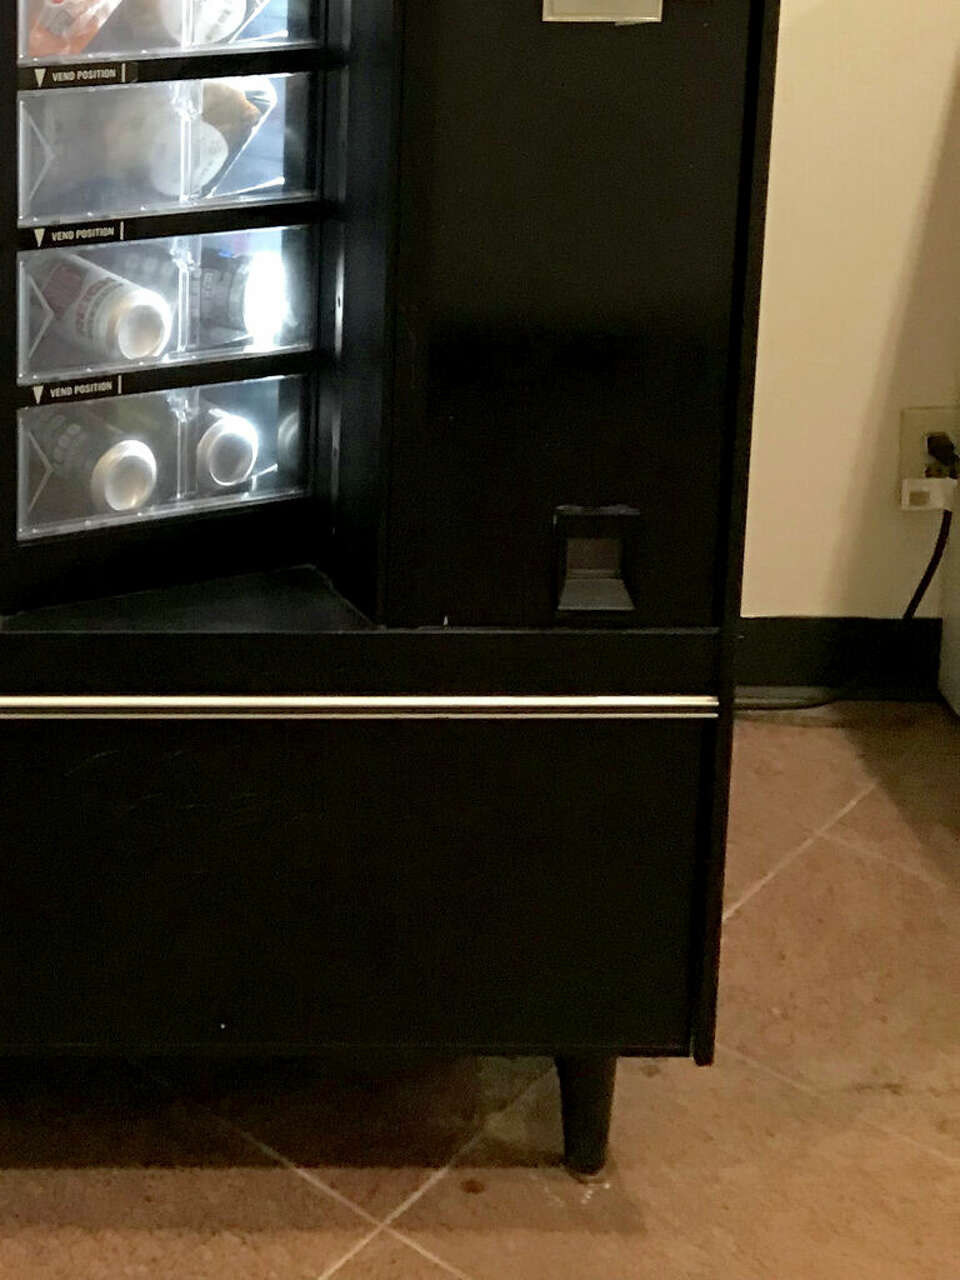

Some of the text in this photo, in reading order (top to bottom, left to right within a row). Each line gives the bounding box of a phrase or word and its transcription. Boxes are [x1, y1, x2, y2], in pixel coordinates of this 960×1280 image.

[52, 69, 116, 81] VEND POSITION
[51, 227, 114, 241] VEND POSITION
[50, 381, 112, 398] VEND POSITION
